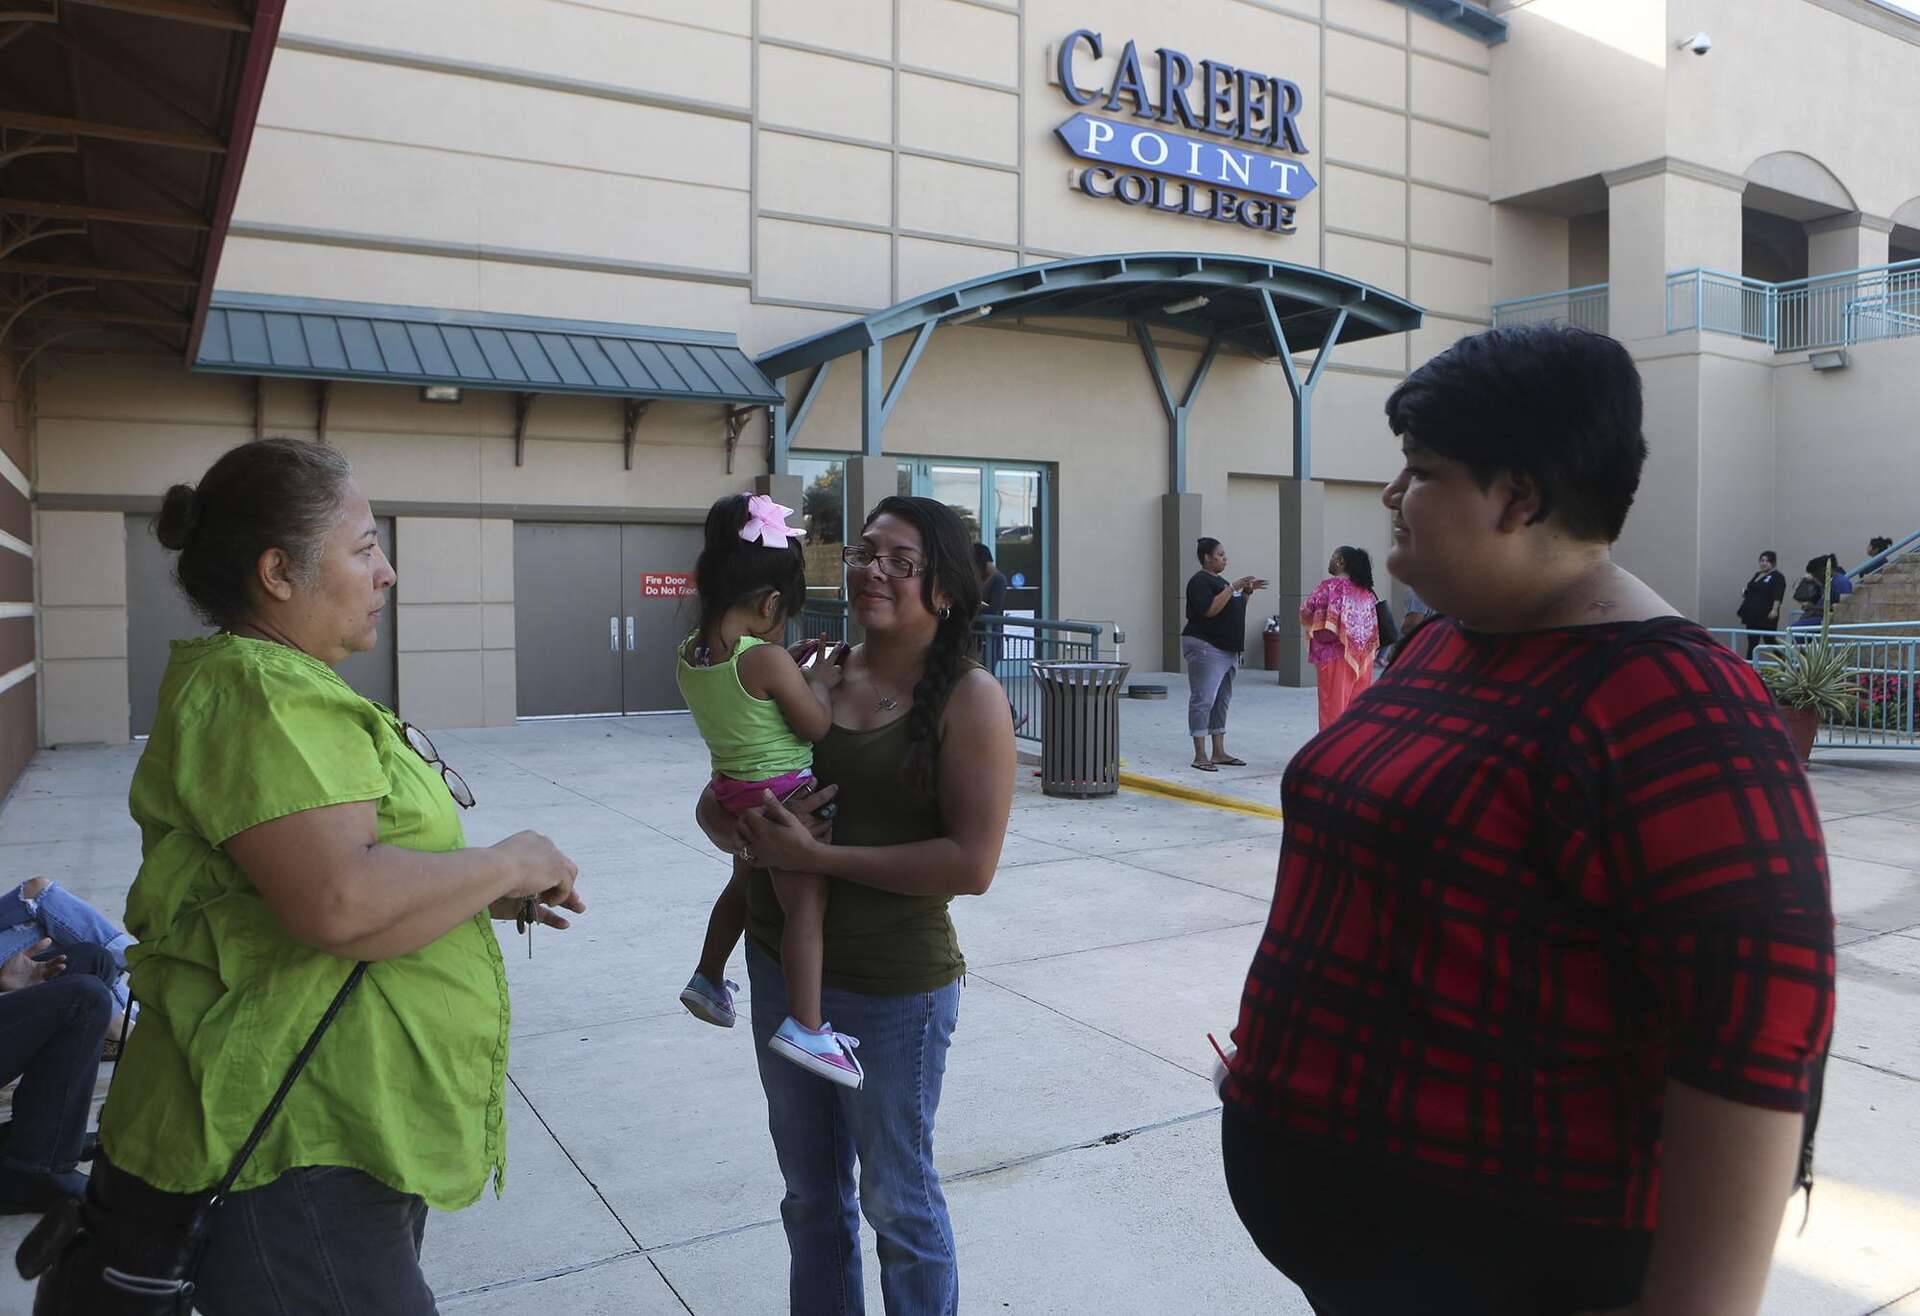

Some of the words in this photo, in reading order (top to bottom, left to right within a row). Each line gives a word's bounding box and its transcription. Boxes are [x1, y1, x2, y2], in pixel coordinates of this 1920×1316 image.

[1057, 29, 1309, 154] CAREER
[1084, 119, 1299, 195] POINT
[1079, 167, 1298, 235] COLLEGE
[646, 576, 662, 585] Fire
[665, 576, 687, 585] Door
[646, 586, 659, 595] Do
[661, 586, 676, 595] Not
